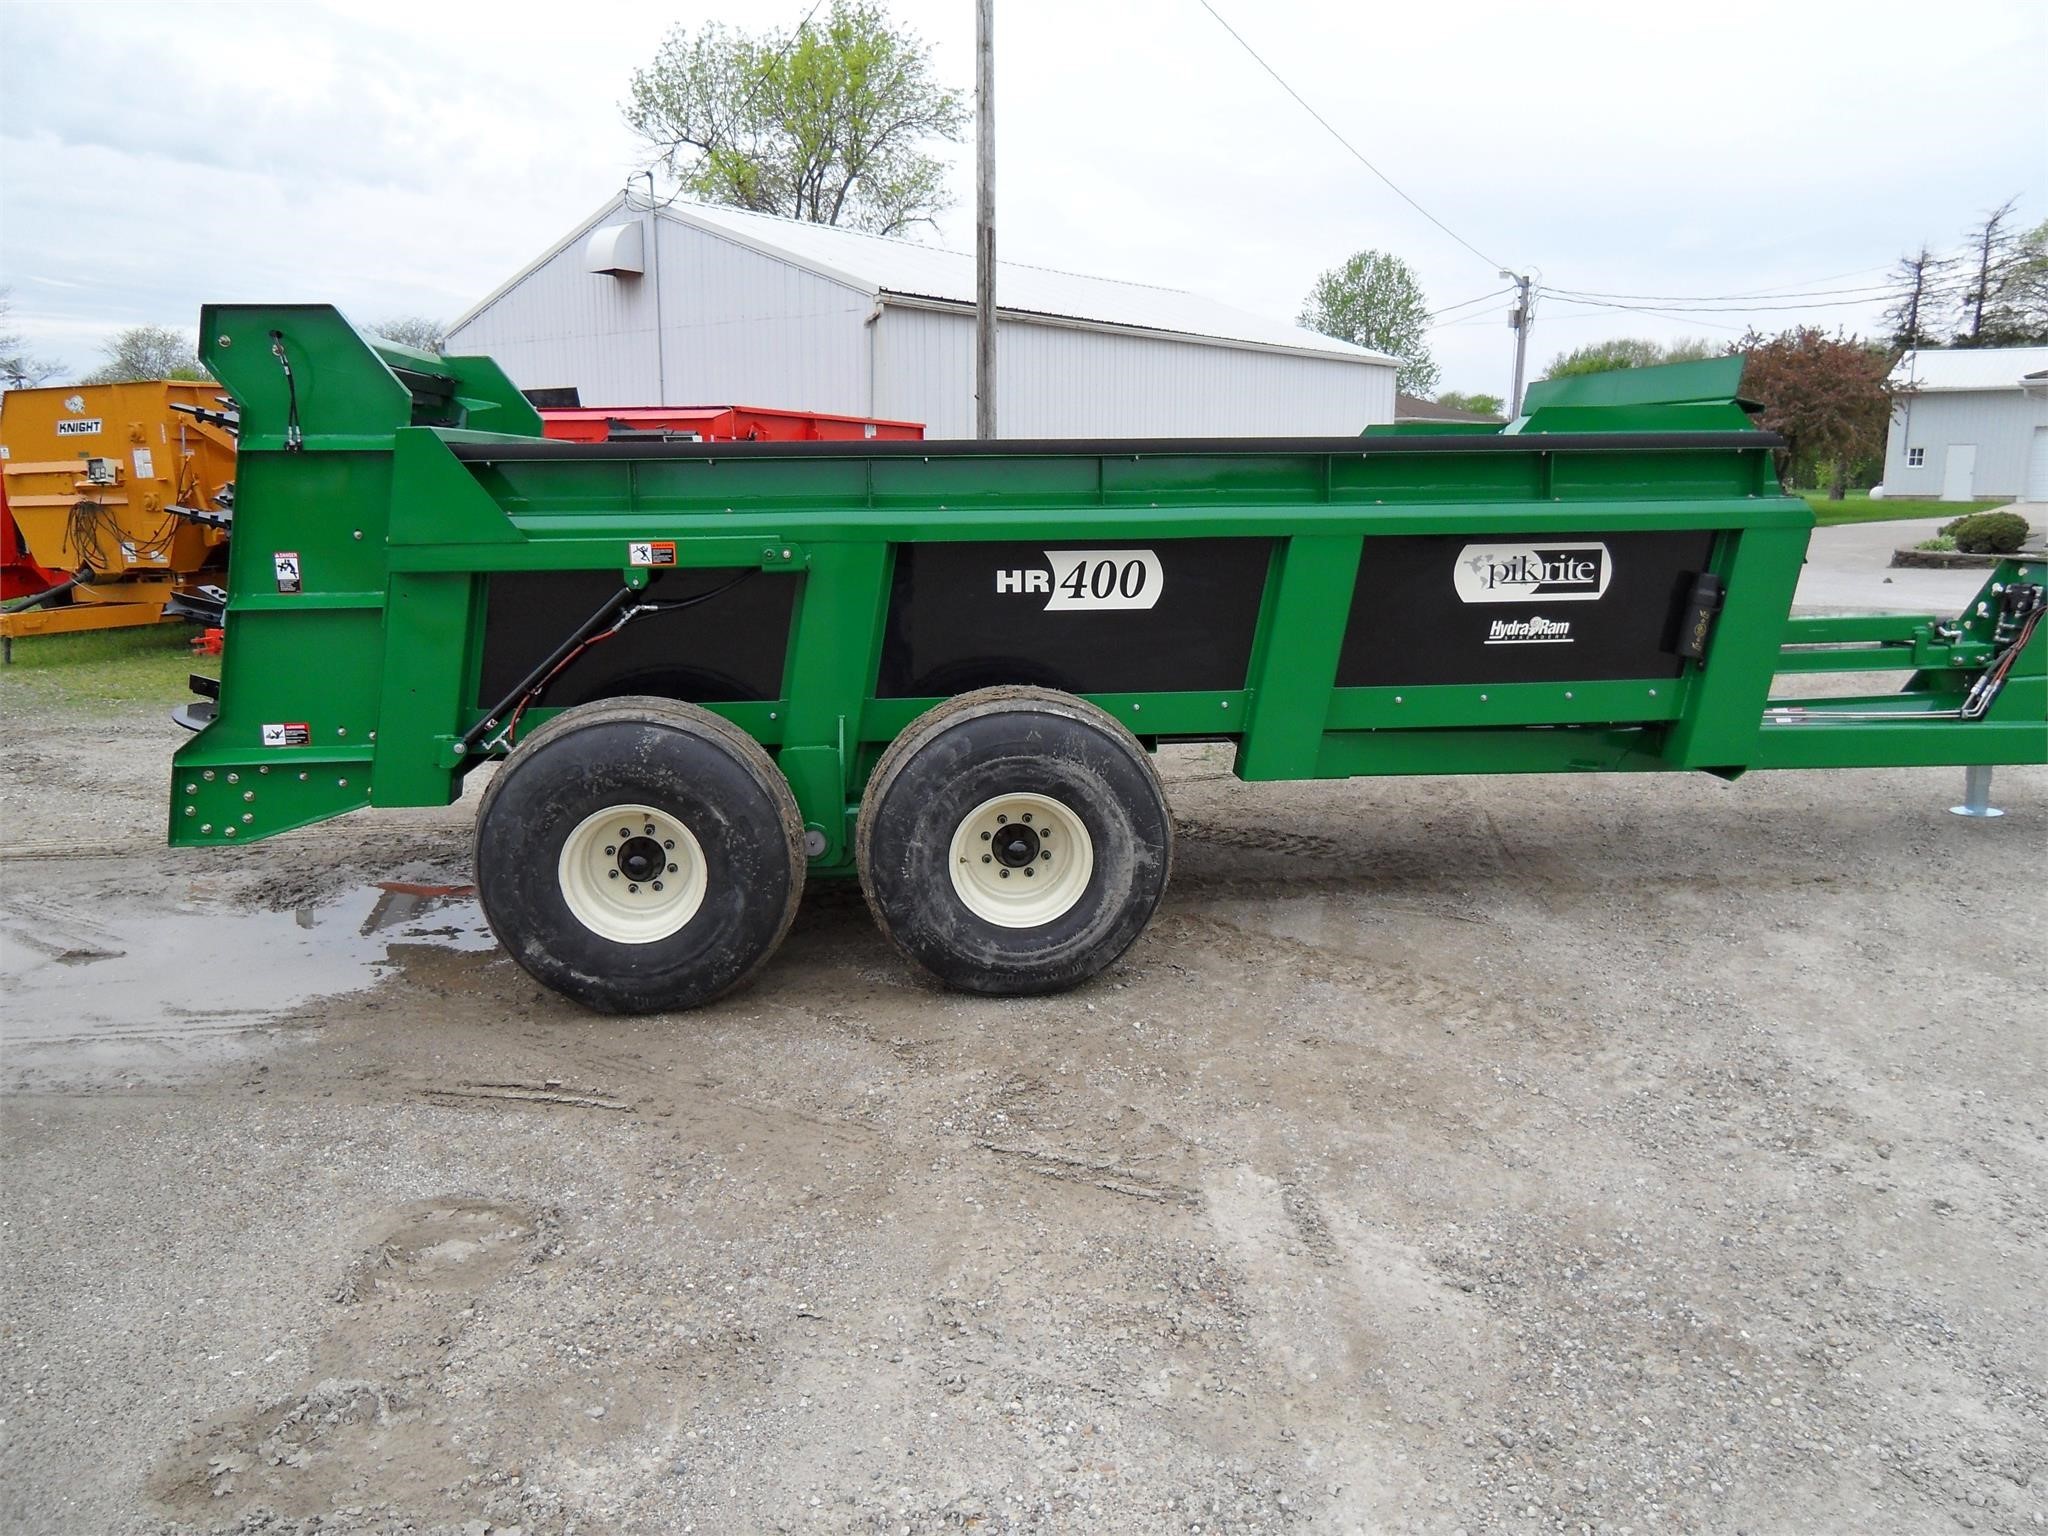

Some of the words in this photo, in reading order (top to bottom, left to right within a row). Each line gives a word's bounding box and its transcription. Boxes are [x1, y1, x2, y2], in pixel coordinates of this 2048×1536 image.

[59, 421, 100, 433] KNIGHT
[996, 570, 1050, 593] HR
[1060, 560, 1147, 599] 400
[1489, 620, 1531, 639] Hydra
[1538, 619, 1570, 635] Ram
